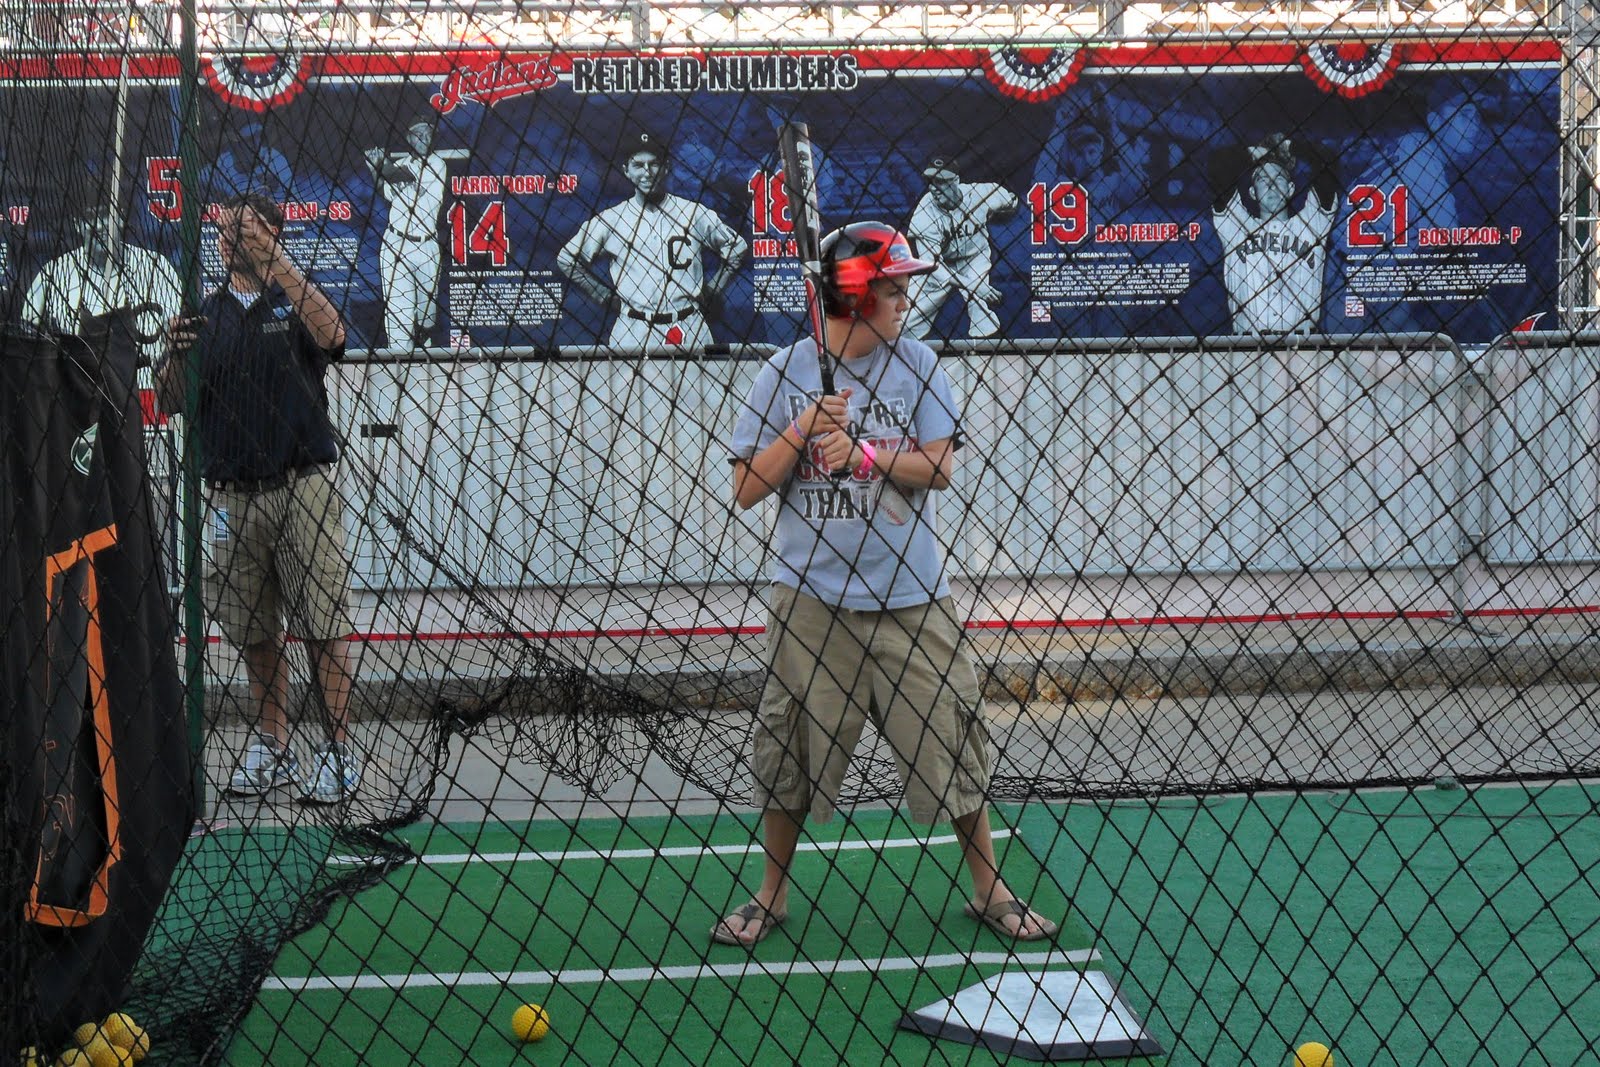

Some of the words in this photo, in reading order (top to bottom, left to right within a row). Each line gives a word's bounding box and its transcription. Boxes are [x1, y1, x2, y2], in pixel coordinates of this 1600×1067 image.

[430, 57, 558, 114] Indians
[573, 57, 701, 92] RETIRED
[707, 54, 858, 92] NUMBERS
[146, 156, 182, 222] 5
[452, 176, 500, 194] LARRY
[557, 175, 577, 194] OF
[748, 171, 794, 235] 18
[329, 201, 350, 220] SS
[1027, 182, 1088, 244] 19
[1347, 184, 1408, 247] 21
[447, 201, 509, 266] 14
[1095, 224, 1127, 243] BOB
[1130, 223, 1178, 242] FELLER
[1189, 222, 1200, 241] P
[1419, 228, 1450, 246] BOB
[1452, 227, 1500, 246] LEMON
[1511, 226, 1522, 244] P
[668, 236, 692, 270] C
[799, 487, 871, 519] THAT
